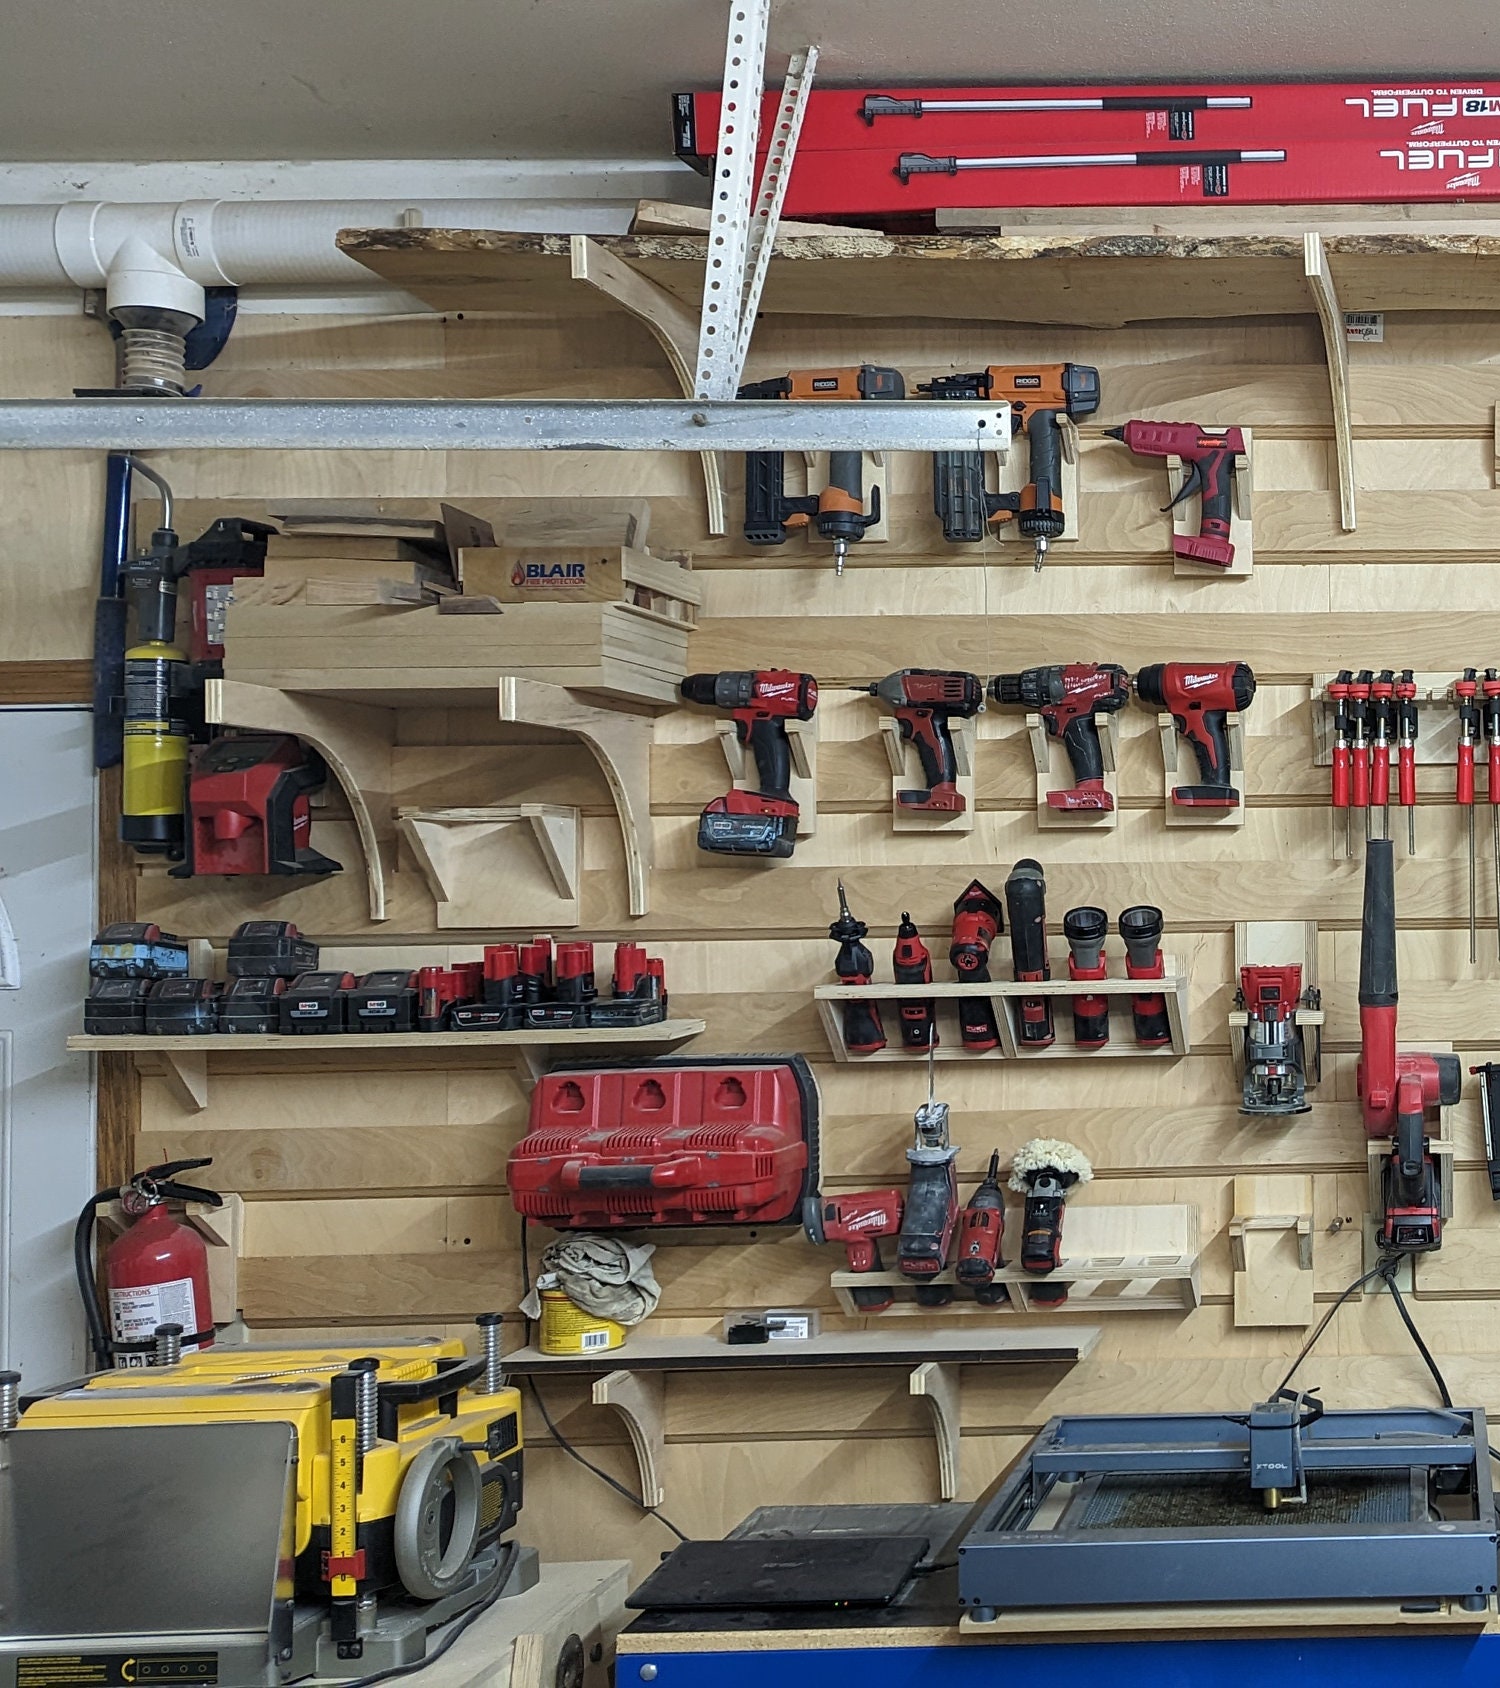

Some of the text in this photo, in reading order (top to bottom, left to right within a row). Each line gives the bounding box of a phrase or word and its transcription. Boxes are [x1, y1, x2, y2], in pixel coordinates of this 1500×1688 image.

[1450, 88, 1484, 96] DRIVEN
[1345, 97, 1458, 118] FUEL
[1379, 148, 1495, 170] FUEL
[526, 563, 586, 578] BLAIR
[1184, 672, 1219, 687] Milwaukee
